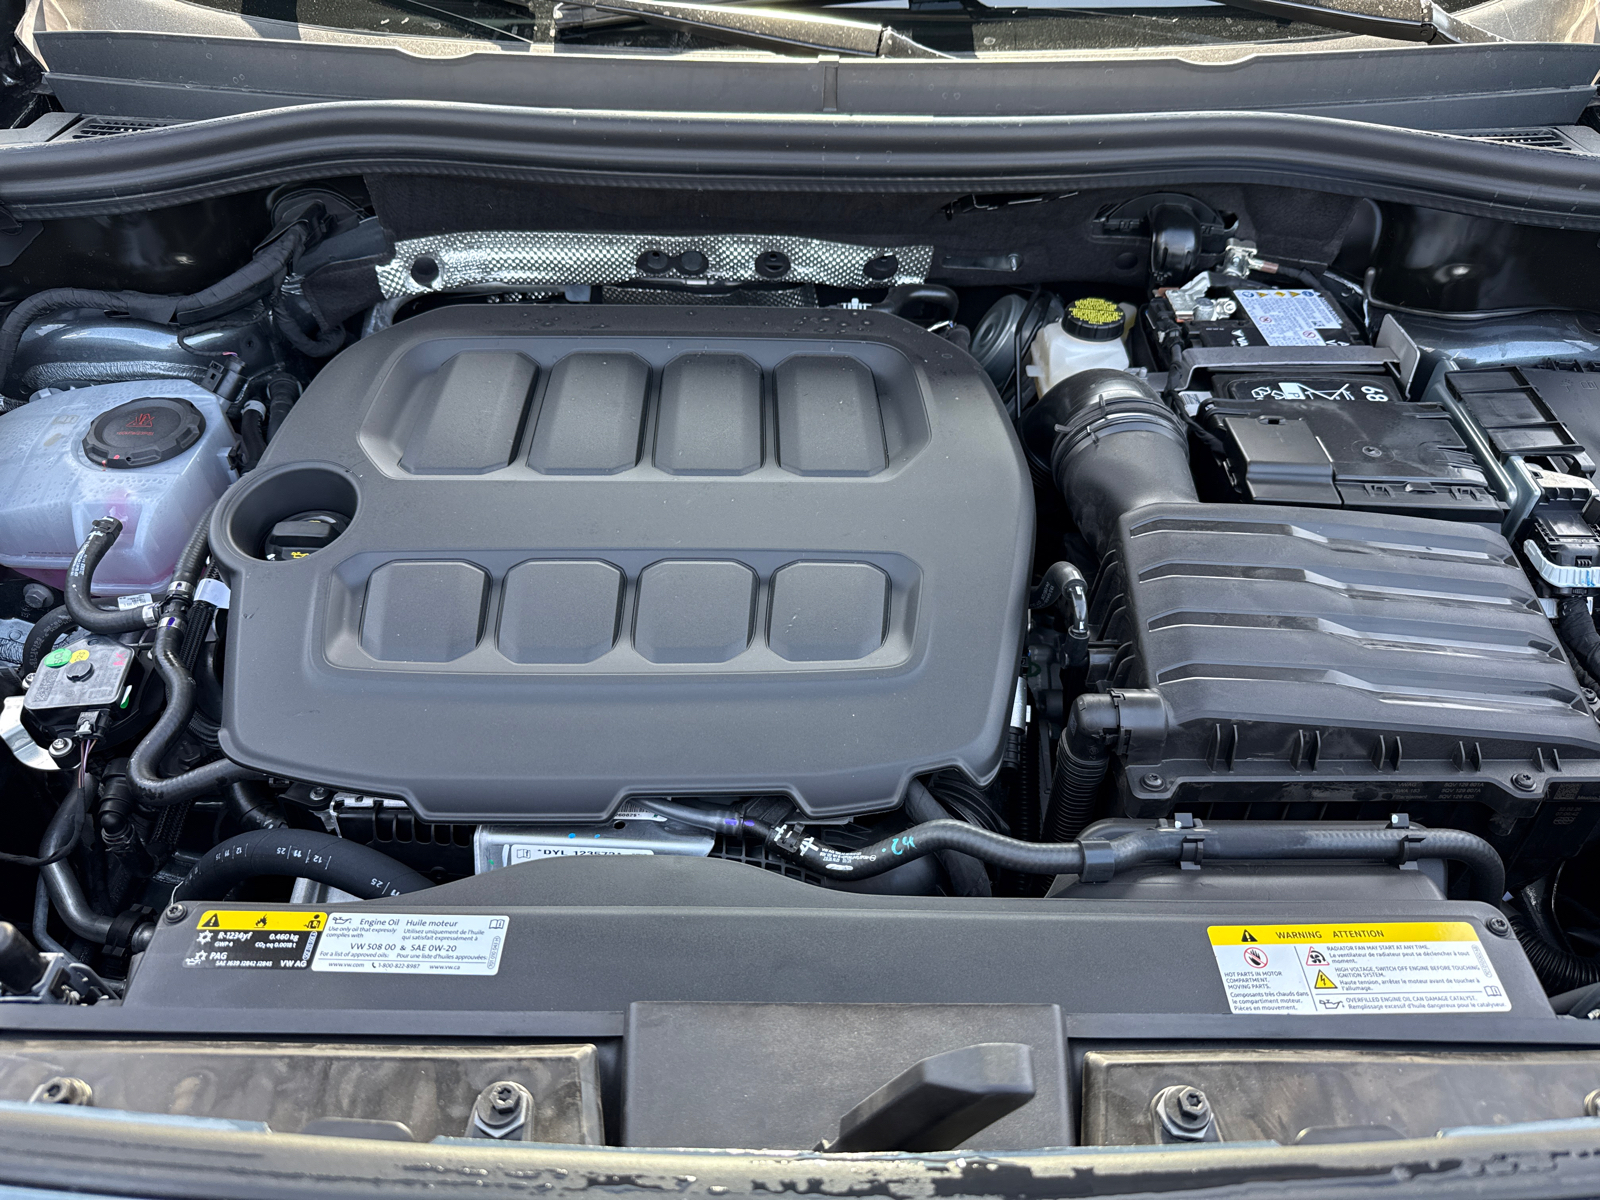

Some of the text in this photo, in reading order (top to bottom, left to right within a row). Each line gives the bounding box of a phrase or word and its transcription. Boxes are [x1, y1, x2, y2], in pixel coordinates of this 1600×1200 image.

[360, 919, 386, 927] Engine
[218, 932, 253, 942] R-1234yf
[1275, 930, 1385, 939] WARNING ATTENTION
[210, 952, 227, 960] PAG
